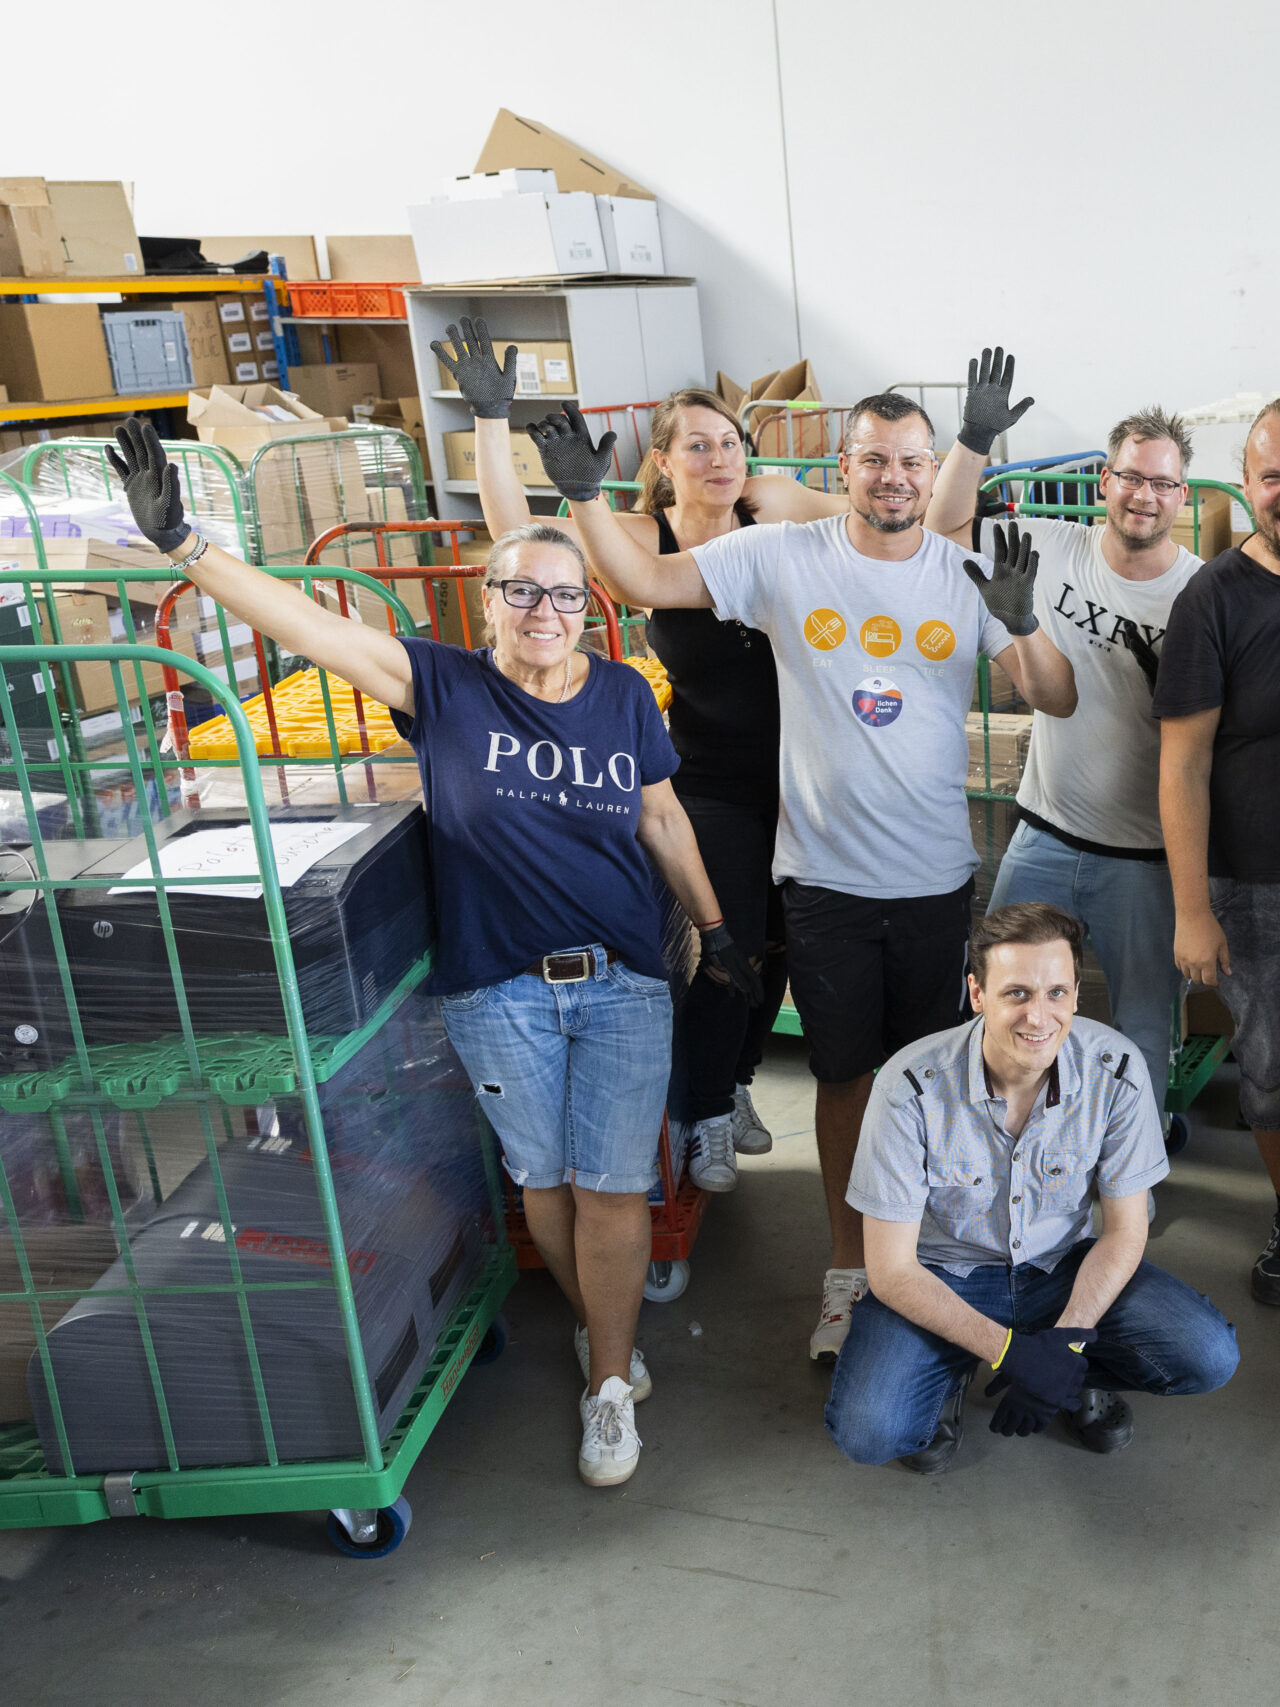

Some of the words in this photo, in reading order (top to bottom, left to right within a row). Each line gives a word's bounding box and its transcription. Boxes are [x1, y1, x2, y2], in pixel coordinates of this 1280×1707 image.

[812, 657, 833, 669] EAT
[862, 663, 896, 674] SLEEP
[922, 666, 945, 678] TILE
[875, 706, 893, 714] Dank
[483, 731, 635, 792] POLO
[496, 788, 551, 802] RALPH
[576, 799, 630, 815] LAUREN
